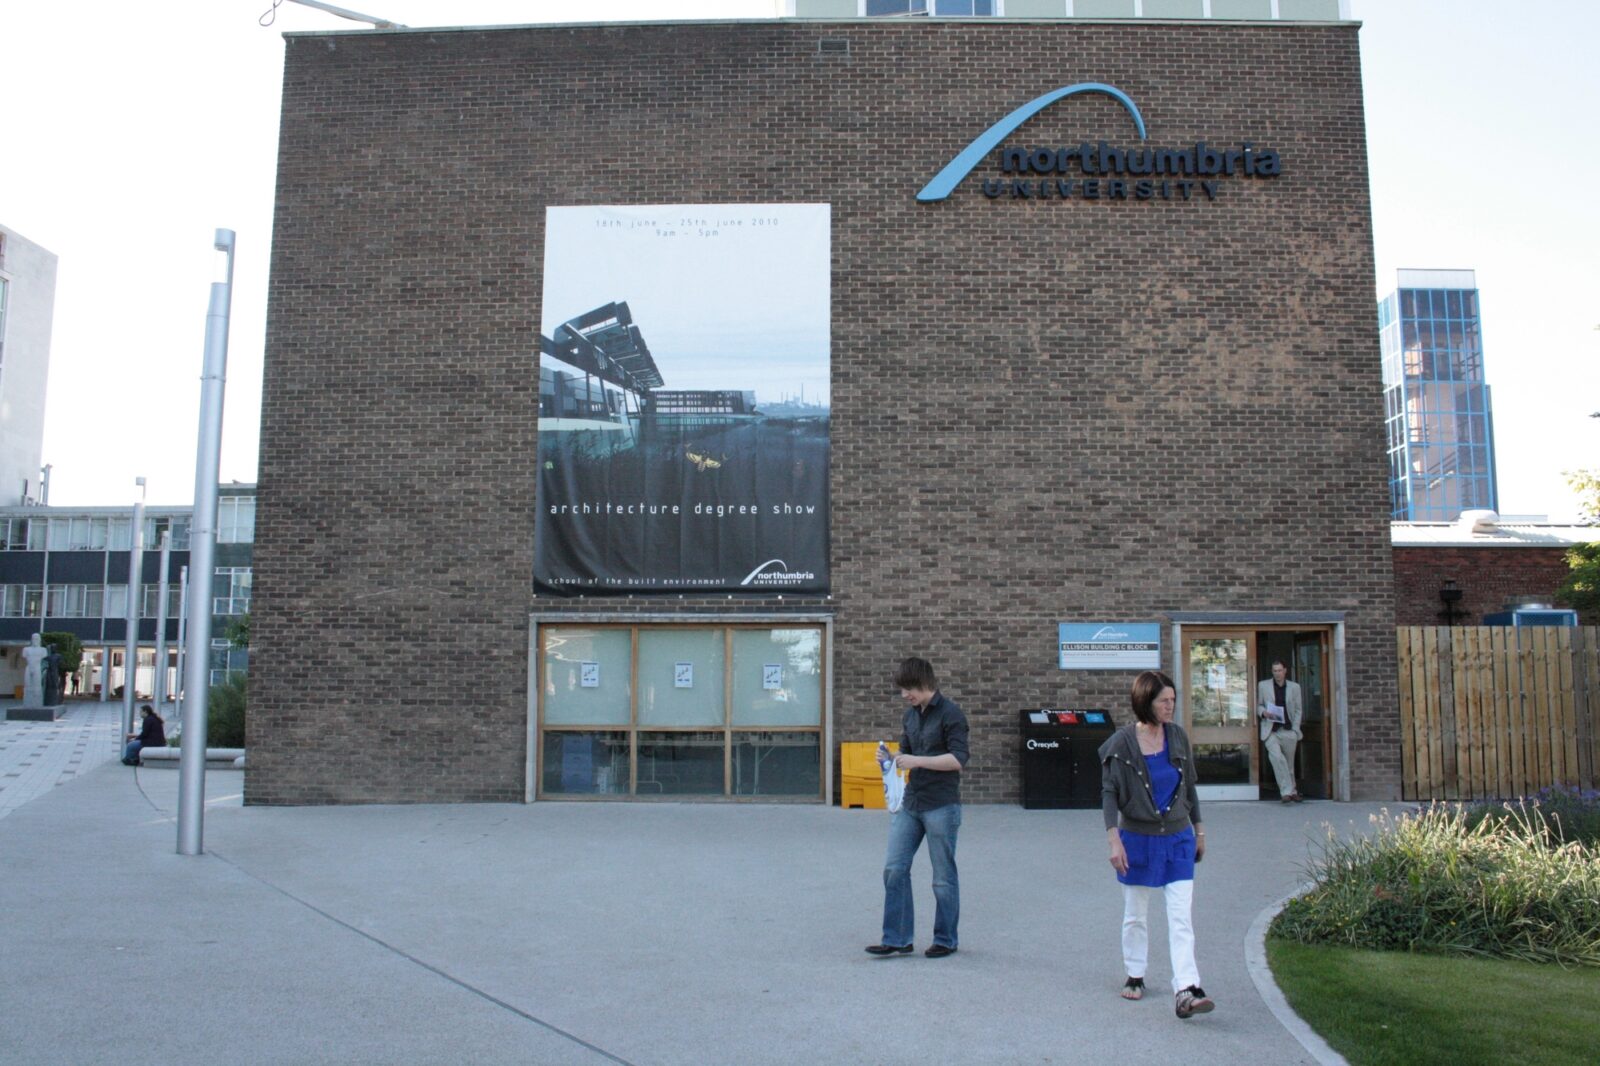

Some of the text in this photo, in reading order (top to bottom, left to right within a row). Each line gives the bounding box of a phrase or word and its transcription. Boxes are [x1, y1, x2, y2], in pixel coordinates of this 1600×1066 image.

[1003, 140, 1281, 176] northumbria
[983, 178, 1219, 200] UNIVERSITY
[631, 219, 657, 229] june
[680, 218, 707, 227] 25th
[717, 219, 743, 229] june
[752, 218, 779, 227] 2010
[656, 229, 676, 237] 9am
[699, 229, 719, 238] 5pm
[550, 502, 816, 517] architecture degree show
[757, 571, 814, 580] northumbria
[548, 577, 726, 585] school of the built environment
[1037, 741, 1059, 750] recycle
